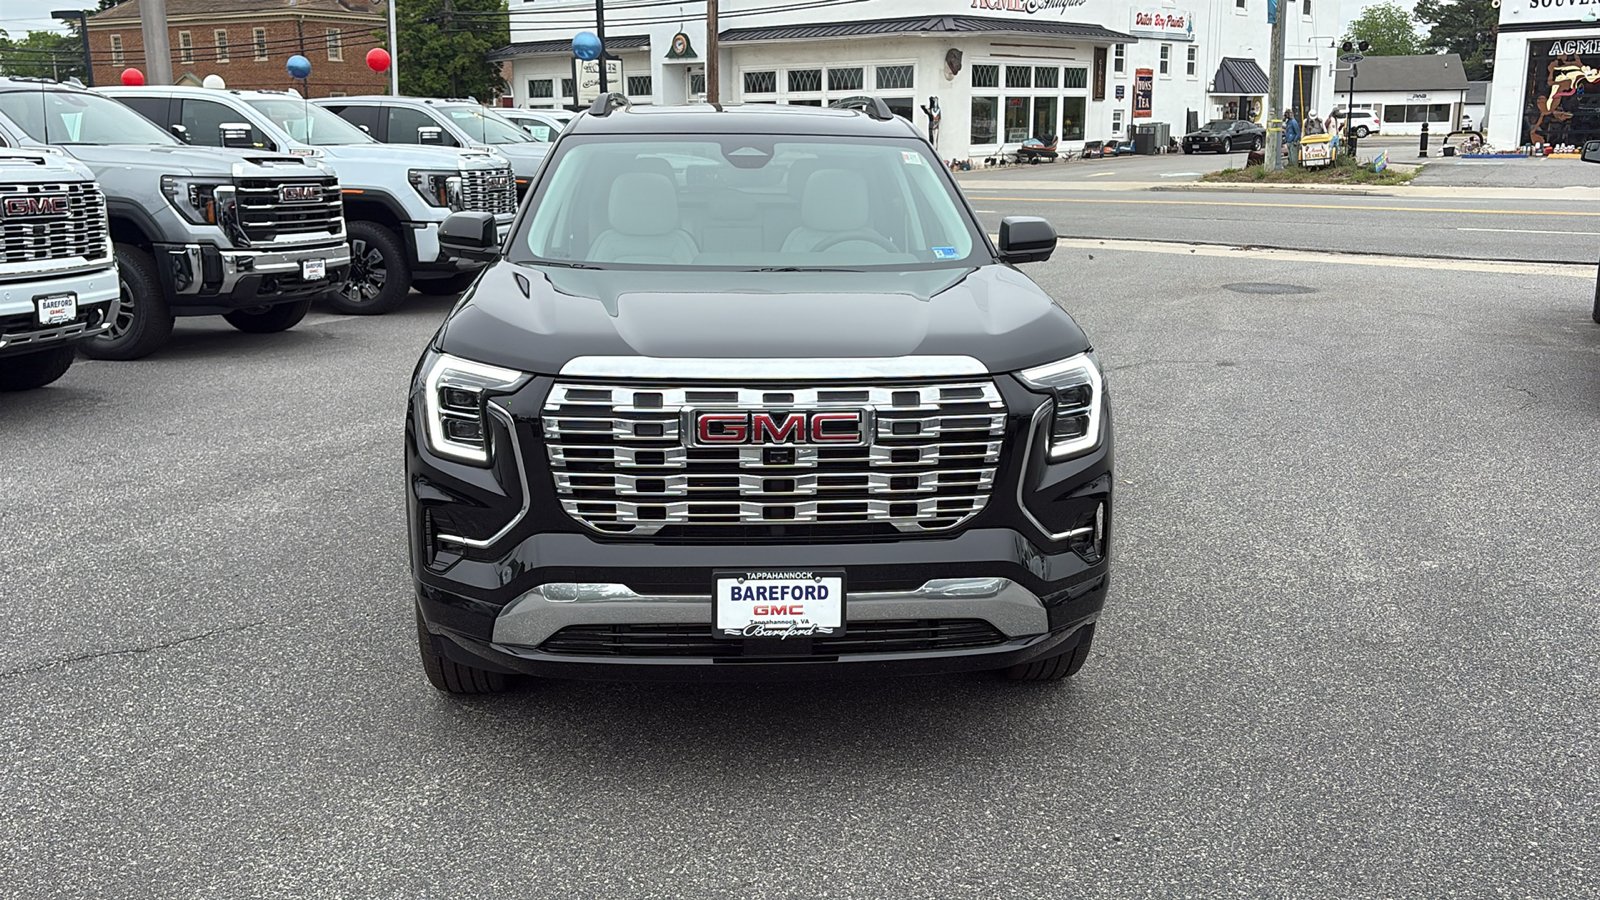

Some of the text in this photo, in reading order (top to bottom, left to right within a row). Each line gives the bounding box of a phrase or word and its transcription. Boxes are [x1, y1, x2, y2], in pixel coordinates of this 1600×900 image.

[1136, 12, 1185, 30] Dutch Boy Paints
[1138, 96, 1150, 108] TEA
[283, 187, 320, 199] GMC
[4, 197, 69, 215] GMC
[42, 299, 73, 310] BAREFORD
[697, 412, 861, 444] GMC
[746, 572, 813, 580] TAPPAHANNOCK
[730, 585, 829, 601] BAREFORD
[753, 605, 804, 616] GMC
[742, 623, 818, 640] Bareford
